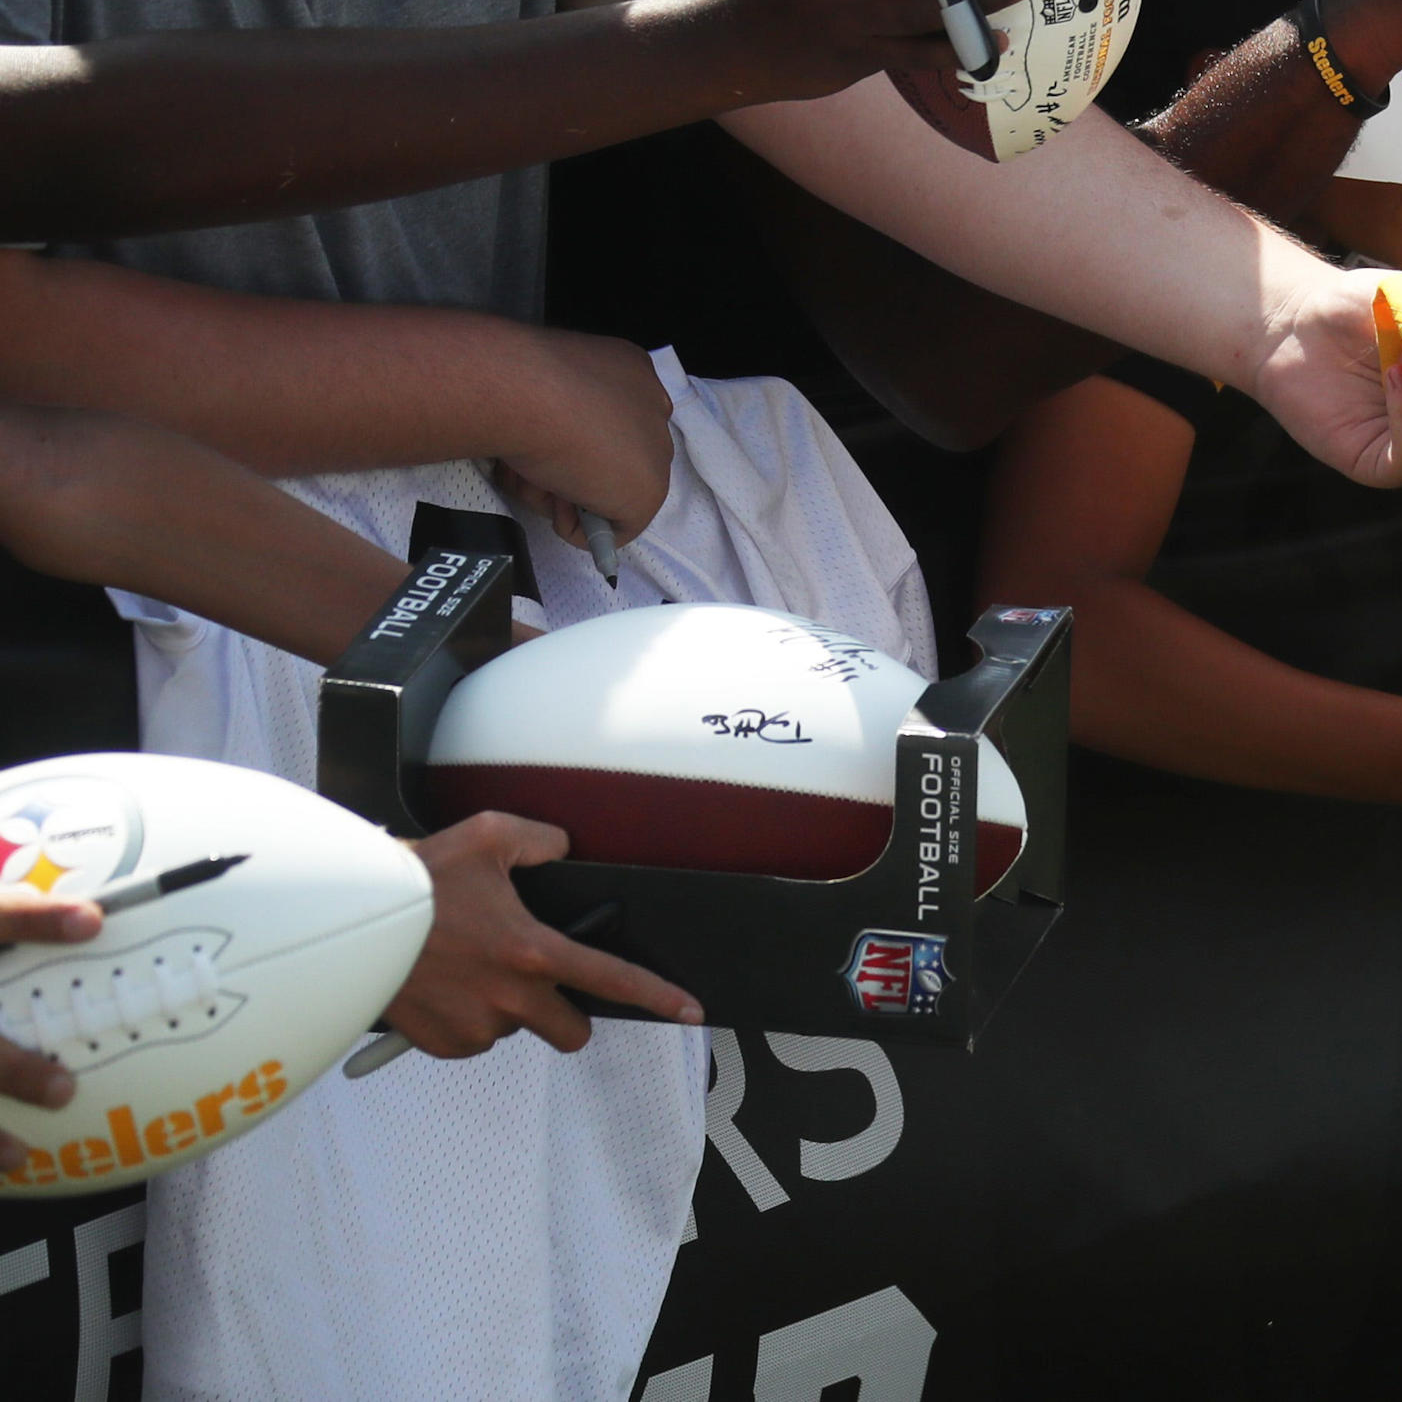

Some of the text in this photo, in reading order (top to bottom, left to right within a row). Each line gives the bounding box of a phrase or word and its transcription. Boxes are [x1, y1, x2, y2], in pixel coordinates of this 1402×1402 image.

[1063, 34, 1077, 83] AMERICAN
[1073, 31, 1088, 81] FOOTBALL
[1083, 21, 1098, 82] CONFERENCE
[1307, 36, 1355, 106] Steelers
[368, 552, 468, 640] FOOTBALL
[435, 558, 493, 618] OFFICIAL SIZE
[917, 752, 943, 921] FOOTBALL
[948, 755, 961, 865] OFFICIAL SIZE
[856, 941, 912, 1012] NFL
